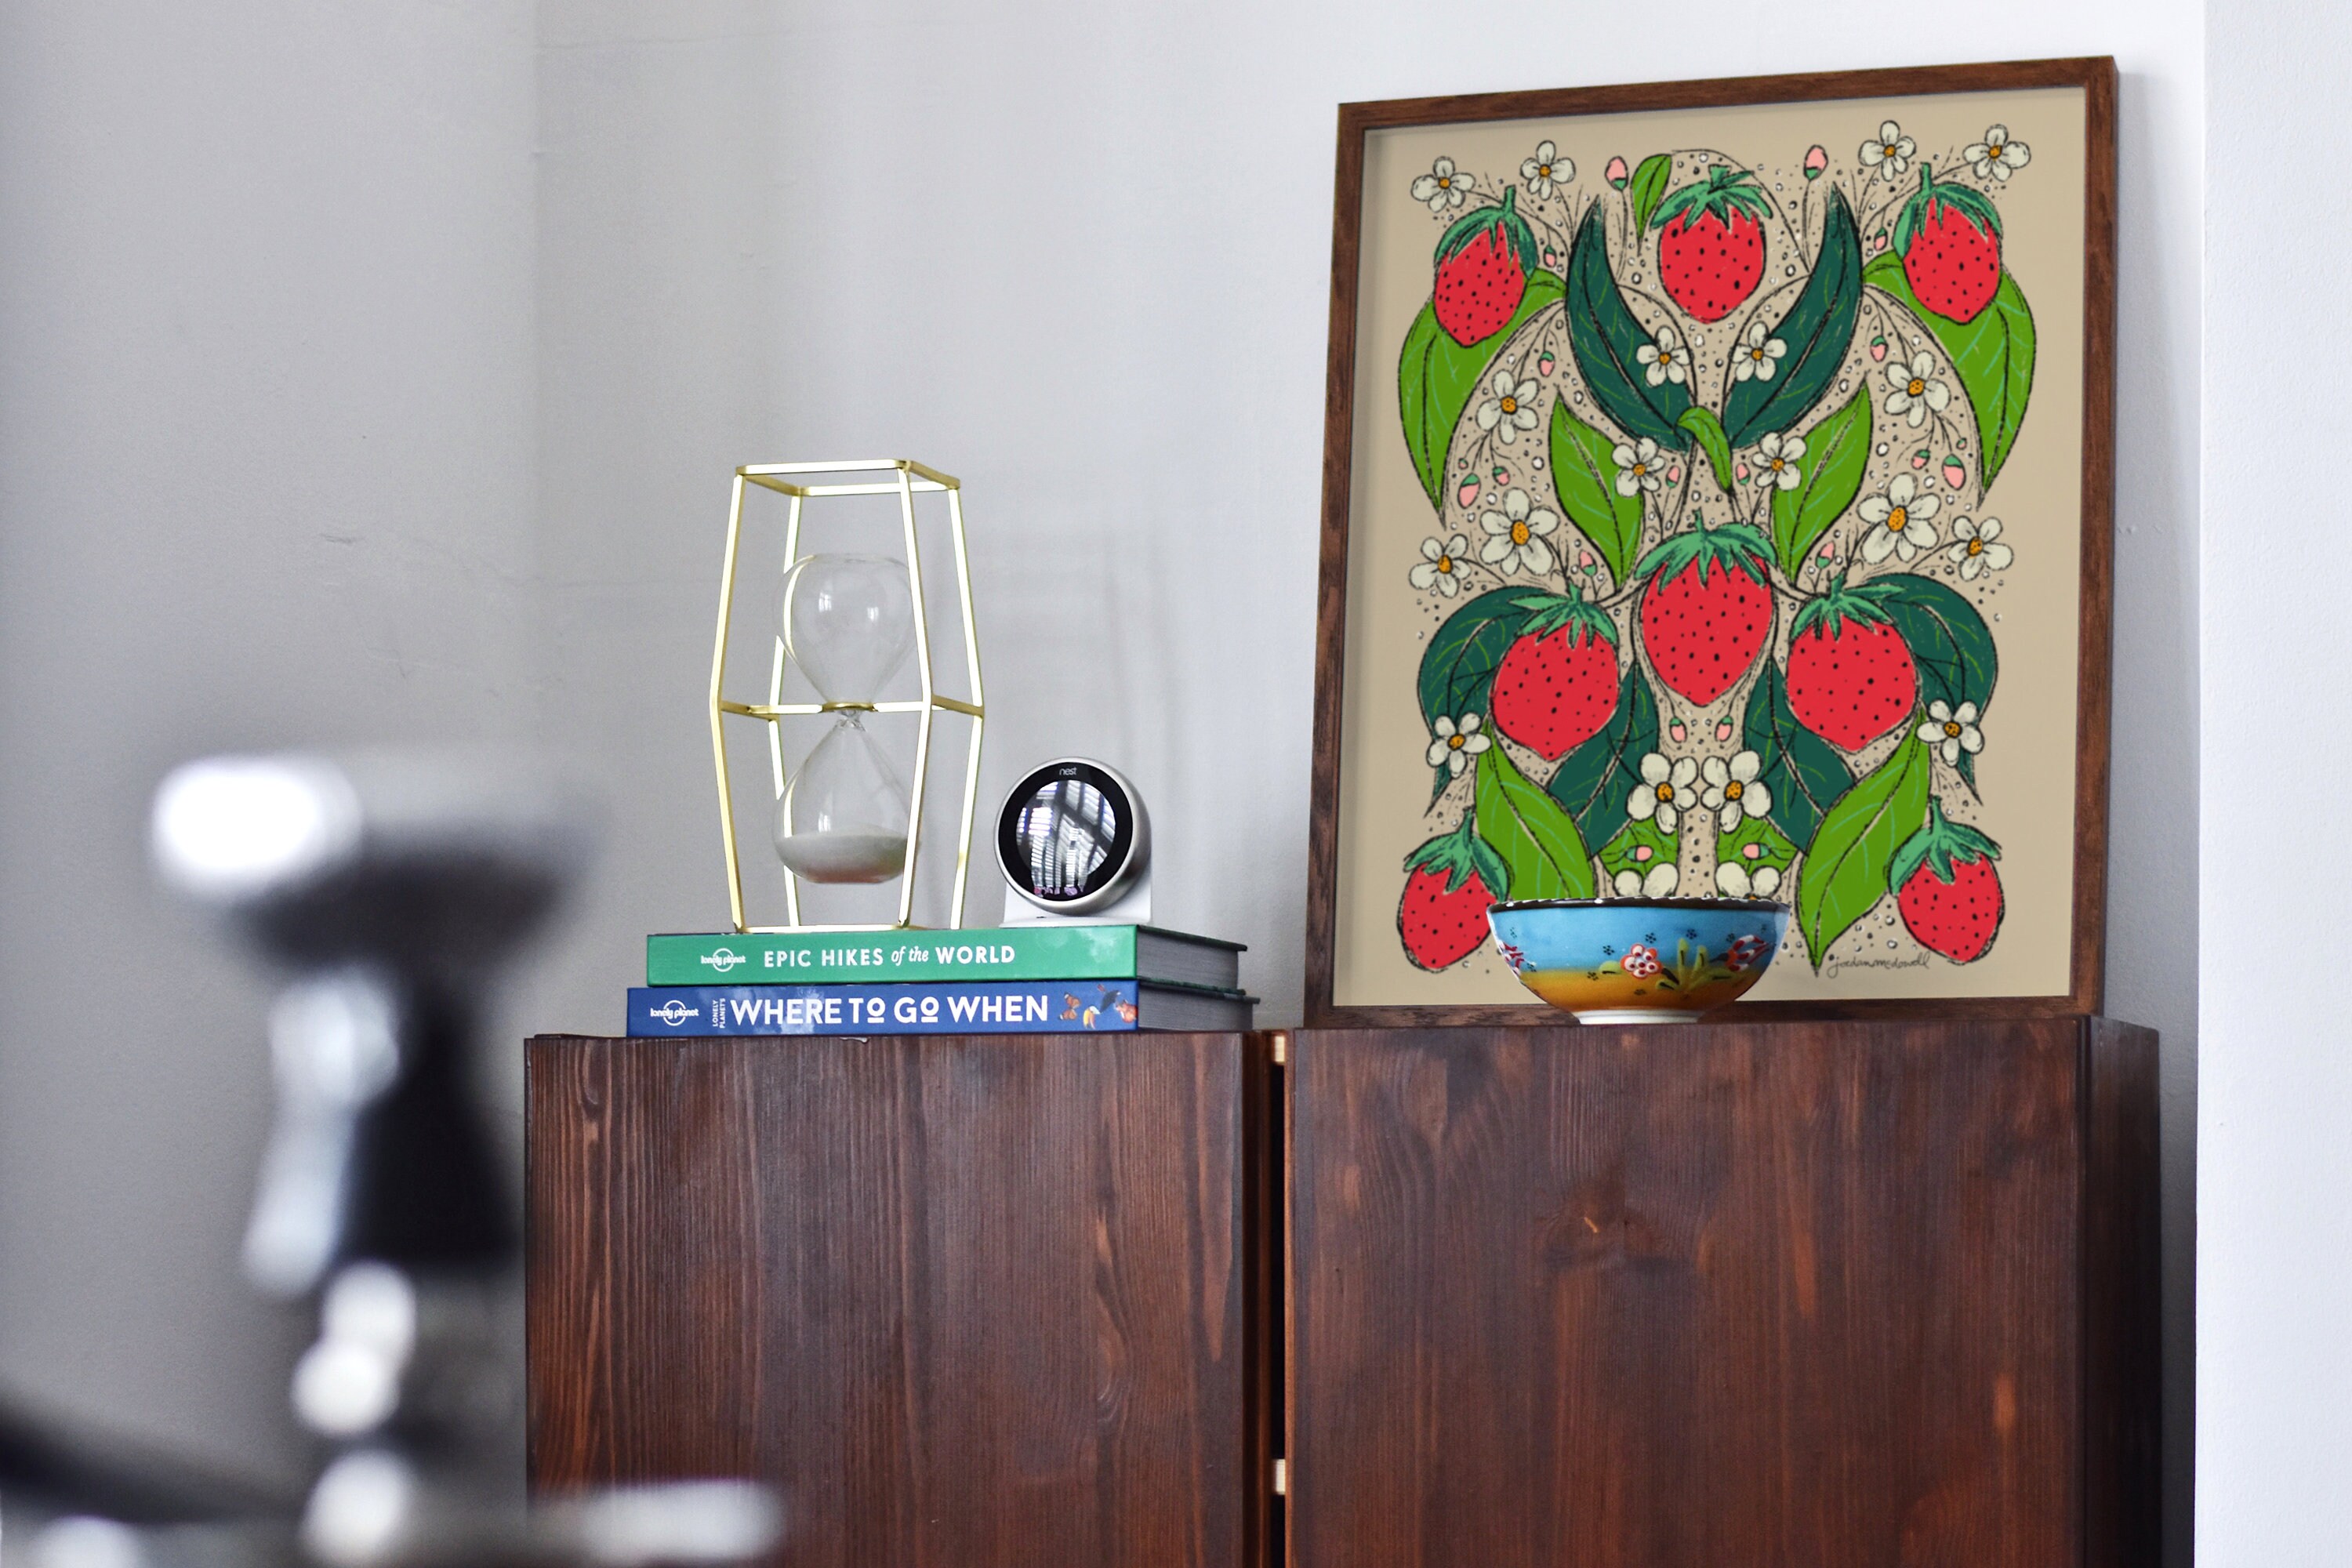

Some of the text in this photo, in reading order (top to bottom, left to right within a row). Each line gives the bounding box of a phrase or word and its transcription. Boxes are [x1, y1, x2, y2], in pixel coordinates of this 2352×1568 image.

[1059, 767, 1078, 775] nest
[700, 955, 746, 966] lonely planet
[764, 945, 1015, 967] EPIC HIKES of the WORLD
[650, 1007, 699, 1019] lonely planet
[729, 995, 1048, 1025] WHERE TO GO WHEN
